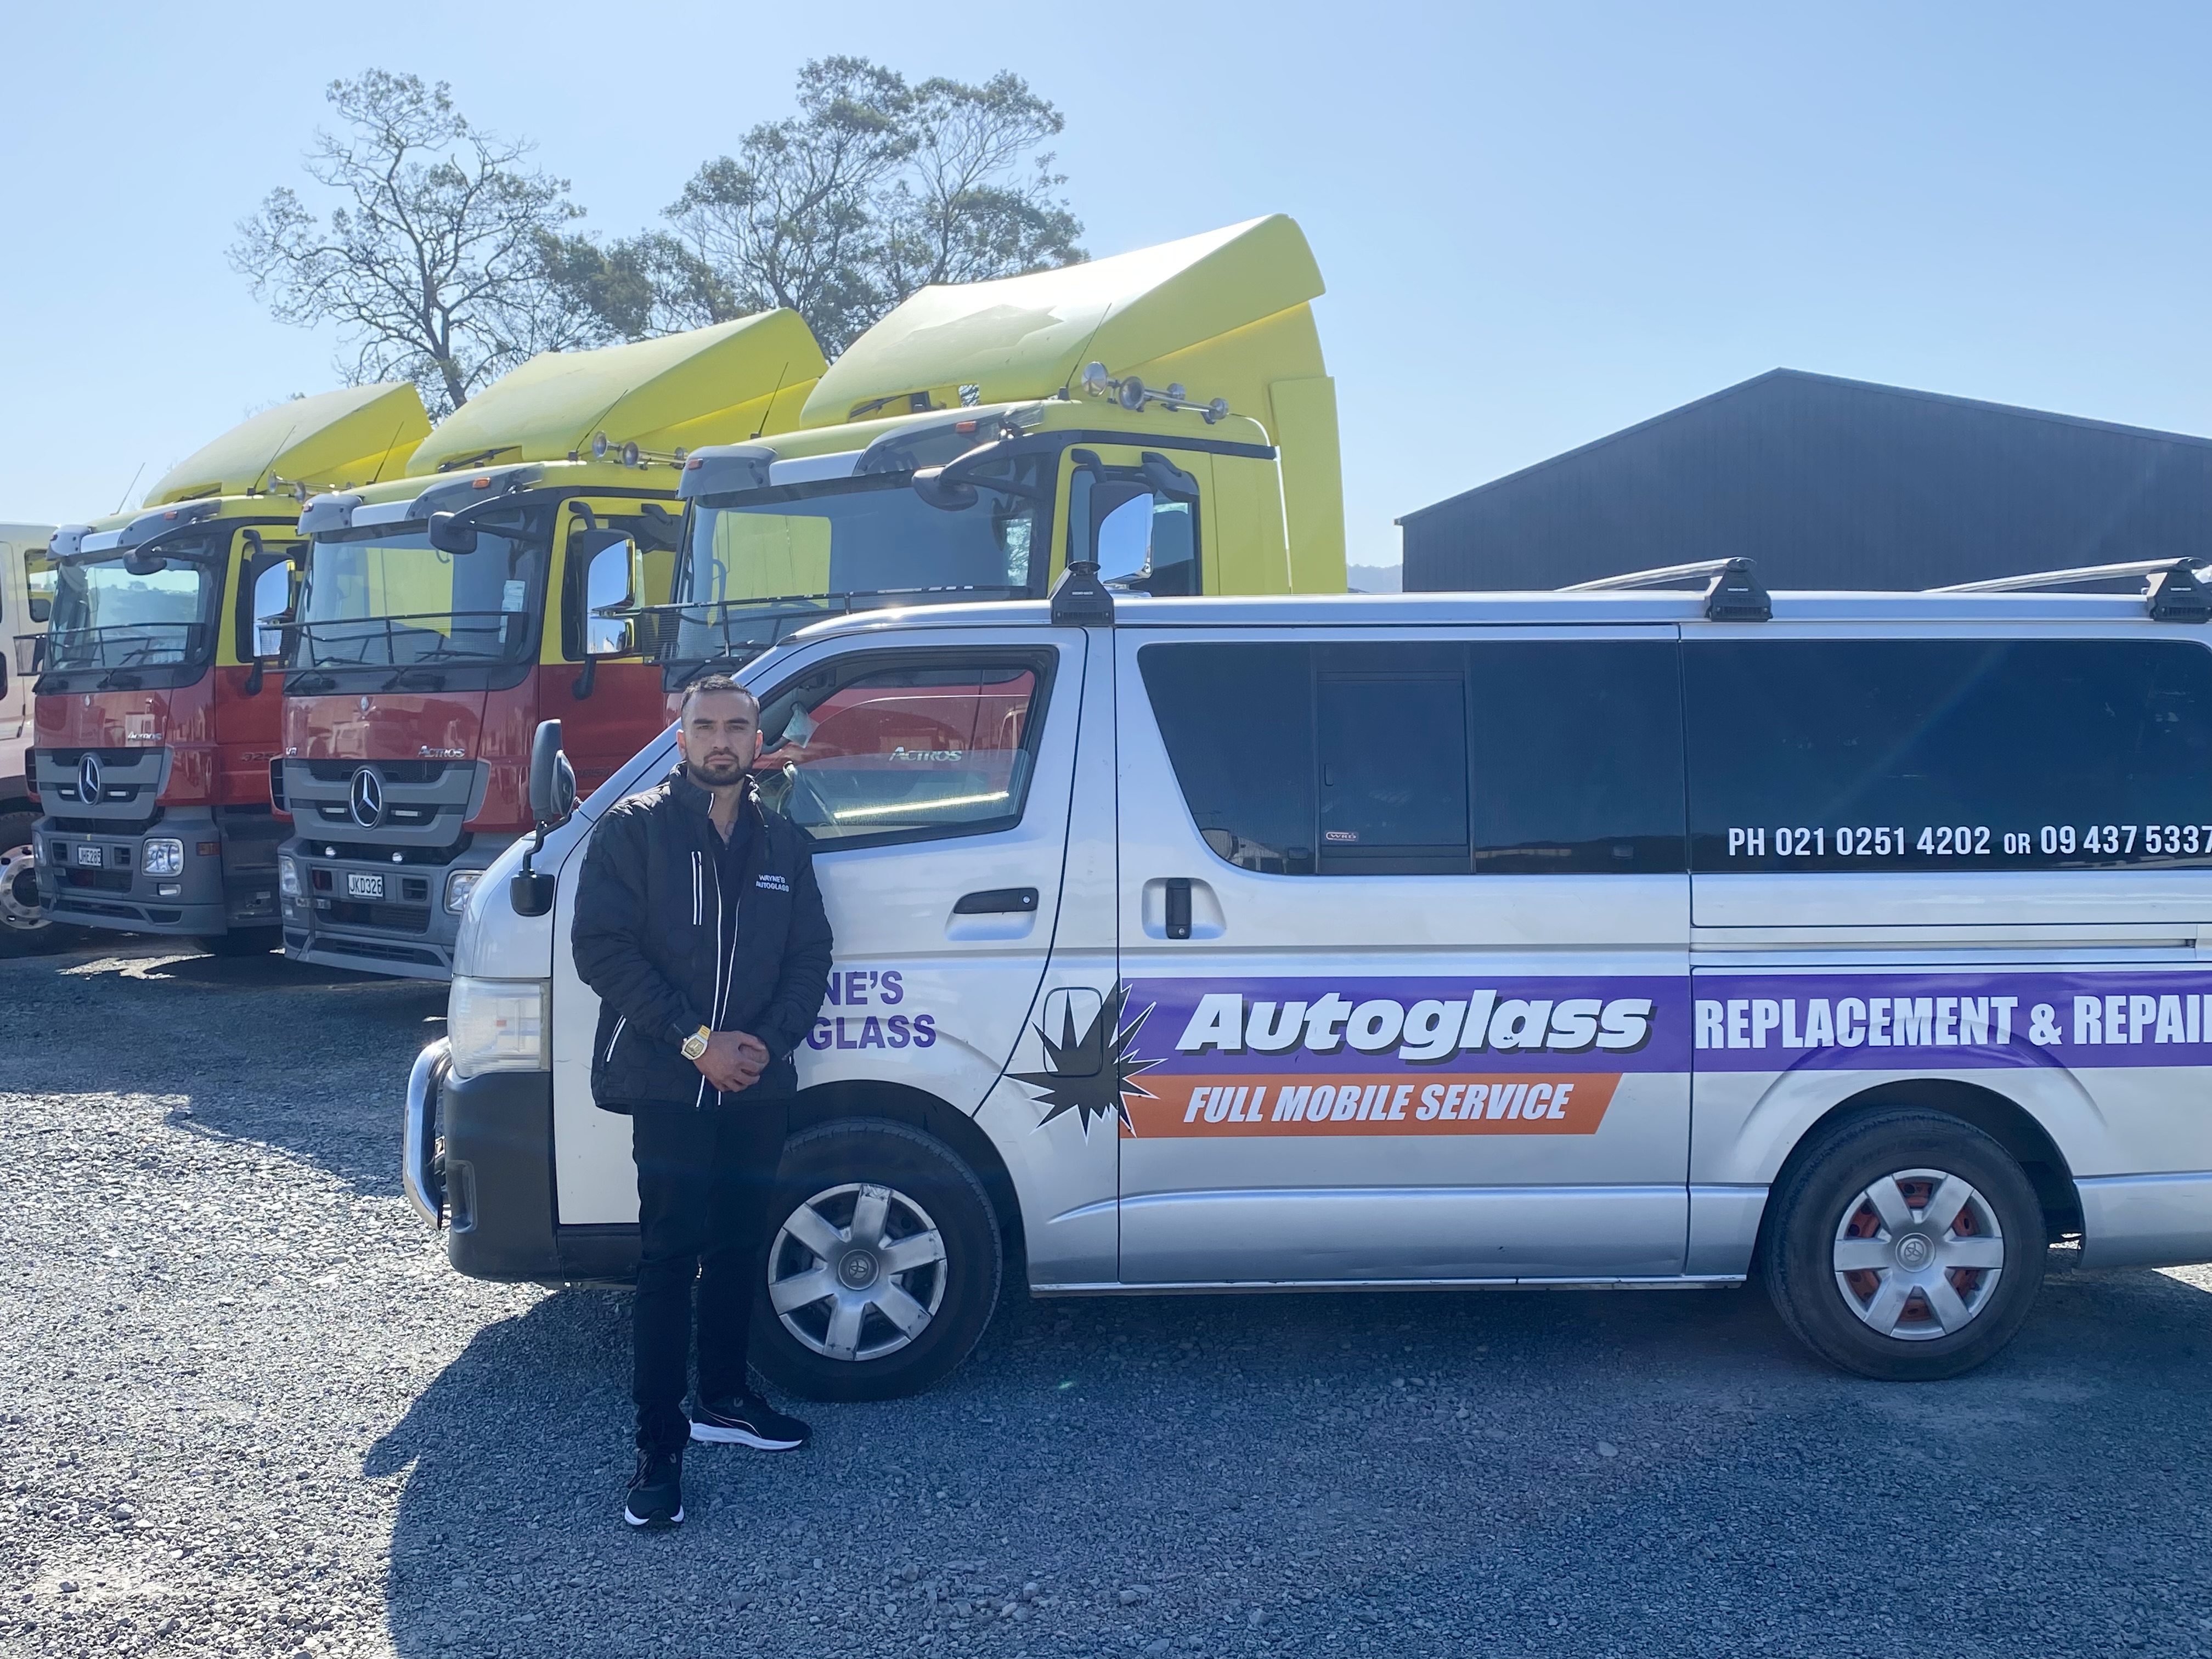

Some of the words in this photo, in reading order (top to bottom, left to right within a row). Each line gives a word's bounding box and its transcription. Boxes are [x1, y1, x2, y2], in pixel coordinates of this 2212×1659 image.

[1729, 828, 1765, 856] PH
[1775, 827, 1824, 856] 021
[1836, 827, 1905, 855] 0251
[1916, 826, 1990, 855] 4202
[2004, 833, 2031, 854] OR
[2040, 826, 2076, 854] 09
[2084, 825, 2137, 854] 437
[2146, 825, 2212, 854] 5337
[350, 877, 382, 894] JKD326
[755, 881, 789, 892] AUTOGLASS
[825, 970, 904, 1006] NE'S
[806, 1014, 936, 1051] GLASS
[1174, 989, 1653, 1061] Autoglass
[1695, 996, 2018, 1049] REPLACEMENT
[2028, 1003, 2063, 1046] &
[1183, 1086, 1267, 1123] FULL
[1271, 1085, 1415, 1122] MOBILE
[1415, 1083, 1575, 1121] SERVICE
